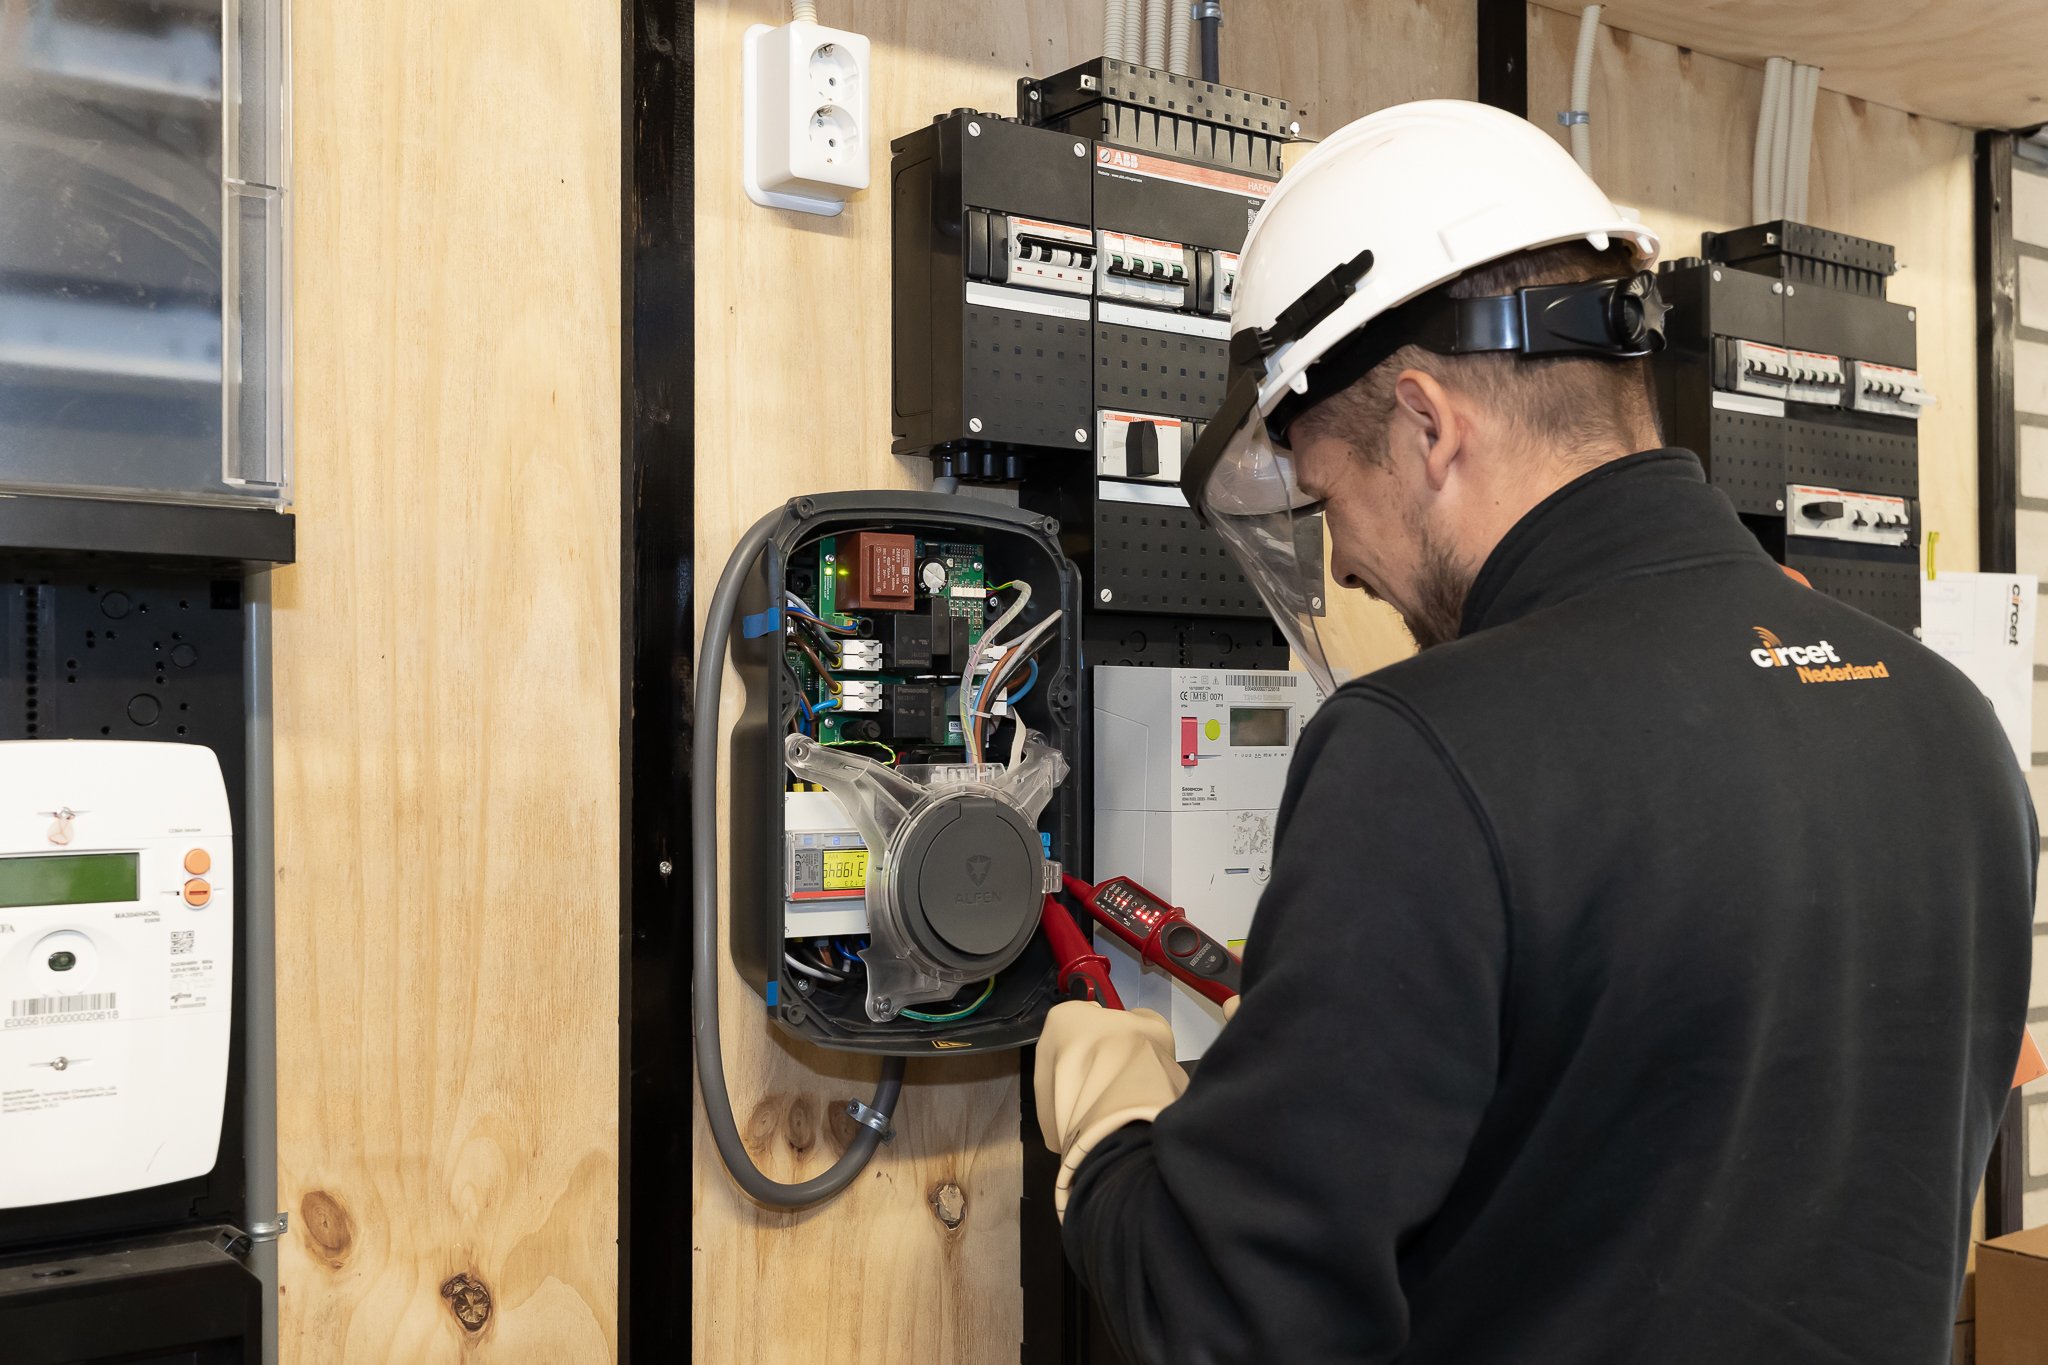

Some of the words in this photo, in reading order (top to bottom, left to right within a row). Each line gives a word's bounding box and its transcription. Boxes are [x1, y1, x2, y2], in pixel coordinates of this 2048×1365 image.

[1113, 151, 1139, 169] ABB
[2009, 584, 2020, 646] circet
[1750, 640, 1841, 668] circet
[1795, 661, 1890, 684] Nederland
[1192, 692, 1207, 701] M18
[1210, 693, 1224, 701] 0071
[954, 890, 1002, 905] ALFEN
